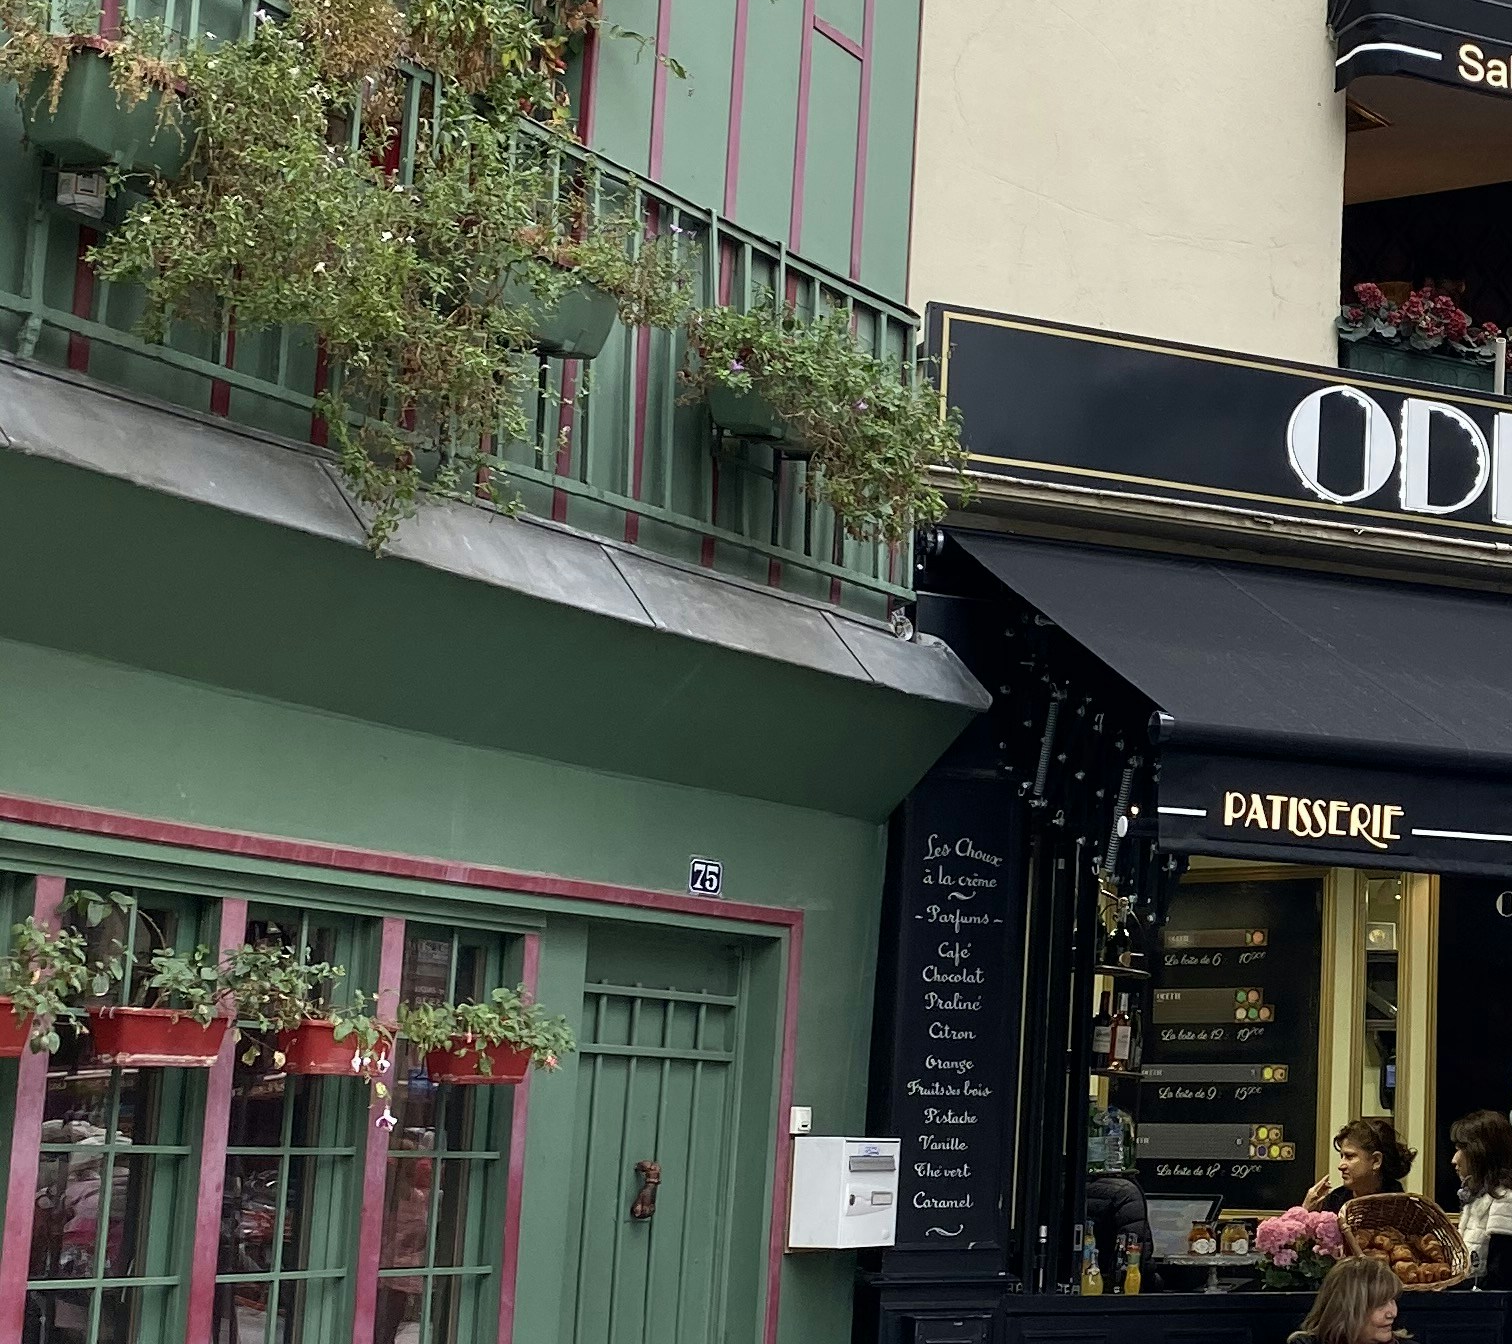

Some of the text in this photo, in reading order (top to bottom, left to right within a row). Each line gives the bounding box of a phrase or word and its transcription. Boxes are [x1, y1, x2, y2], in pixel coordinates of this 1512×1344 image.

[1223, 791, 1405, 849] PATISSERIE
[923, 833, 1003, 868] Les Choux
[693, 863, 719, 891] 75
[939, 865, 956, 886] la
[926, 904, 989, 933] Parfums
[938, 942, 971, 967] Café
[1212, 952, 1223, 966] 6
[922, 965, 985, 984] Chocolat
[924, 991, 983, 1011] Praliné
[929, 1021, 977, 1040] Citron
[925, 1054, 974, 1075] Orange
[907, 1078, 945, 1096] Fruits
[963, 1080, 993, 1097] bois
[1206, 1086, 1217, 1100] 9
[924, 1107, 979, 1124] Pistache
[918, 1135, 969, 1151] Vanille
[914, 1162, 971, 1178] Thé vert
[913, 1191, 974, 1209] Caramel
